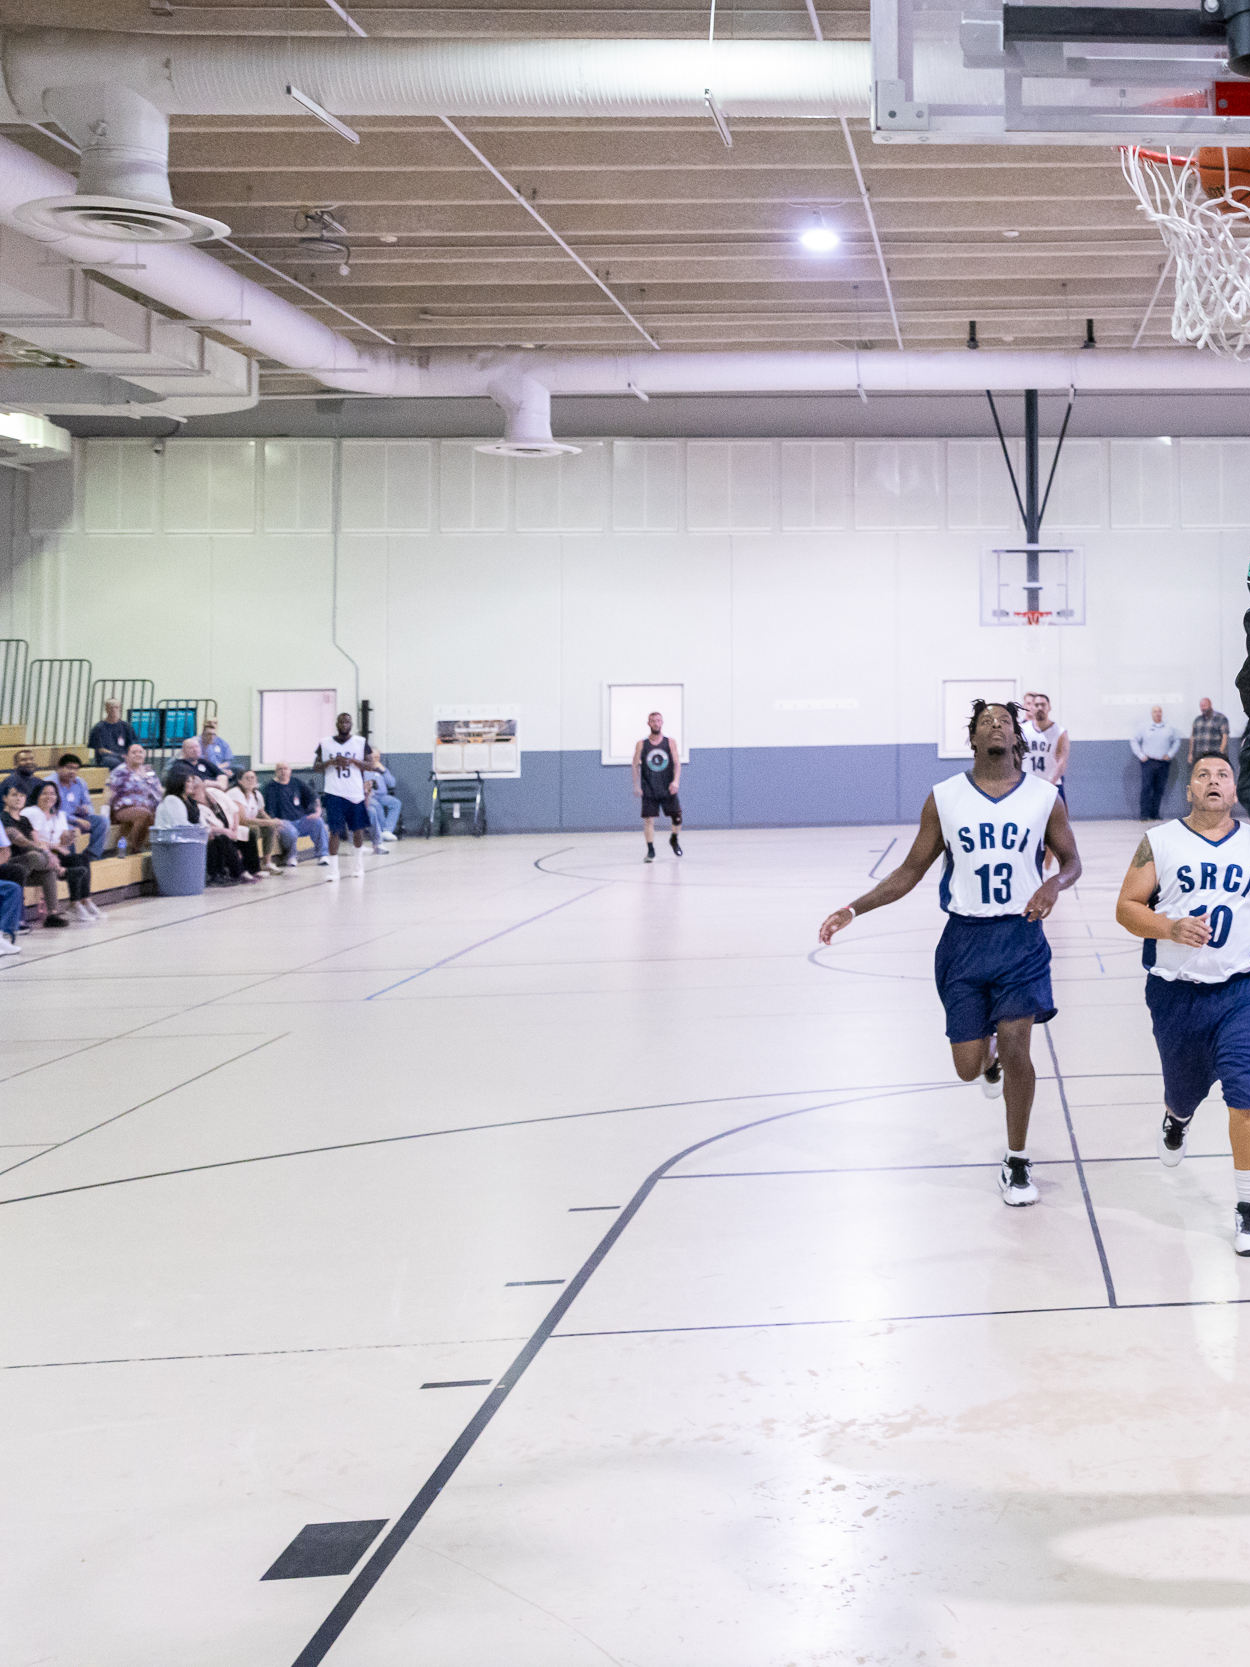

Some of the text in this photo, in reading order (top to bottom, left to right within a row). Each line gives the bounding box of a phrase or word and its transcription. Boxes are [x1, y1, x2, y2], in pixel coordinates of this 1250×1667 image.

[335, 766, 351, 779] 15
[1030, 756, 1045, 772] 14
[958, 822, 1031, 853] SRCI
[974, 862, 1013, 905] 13
